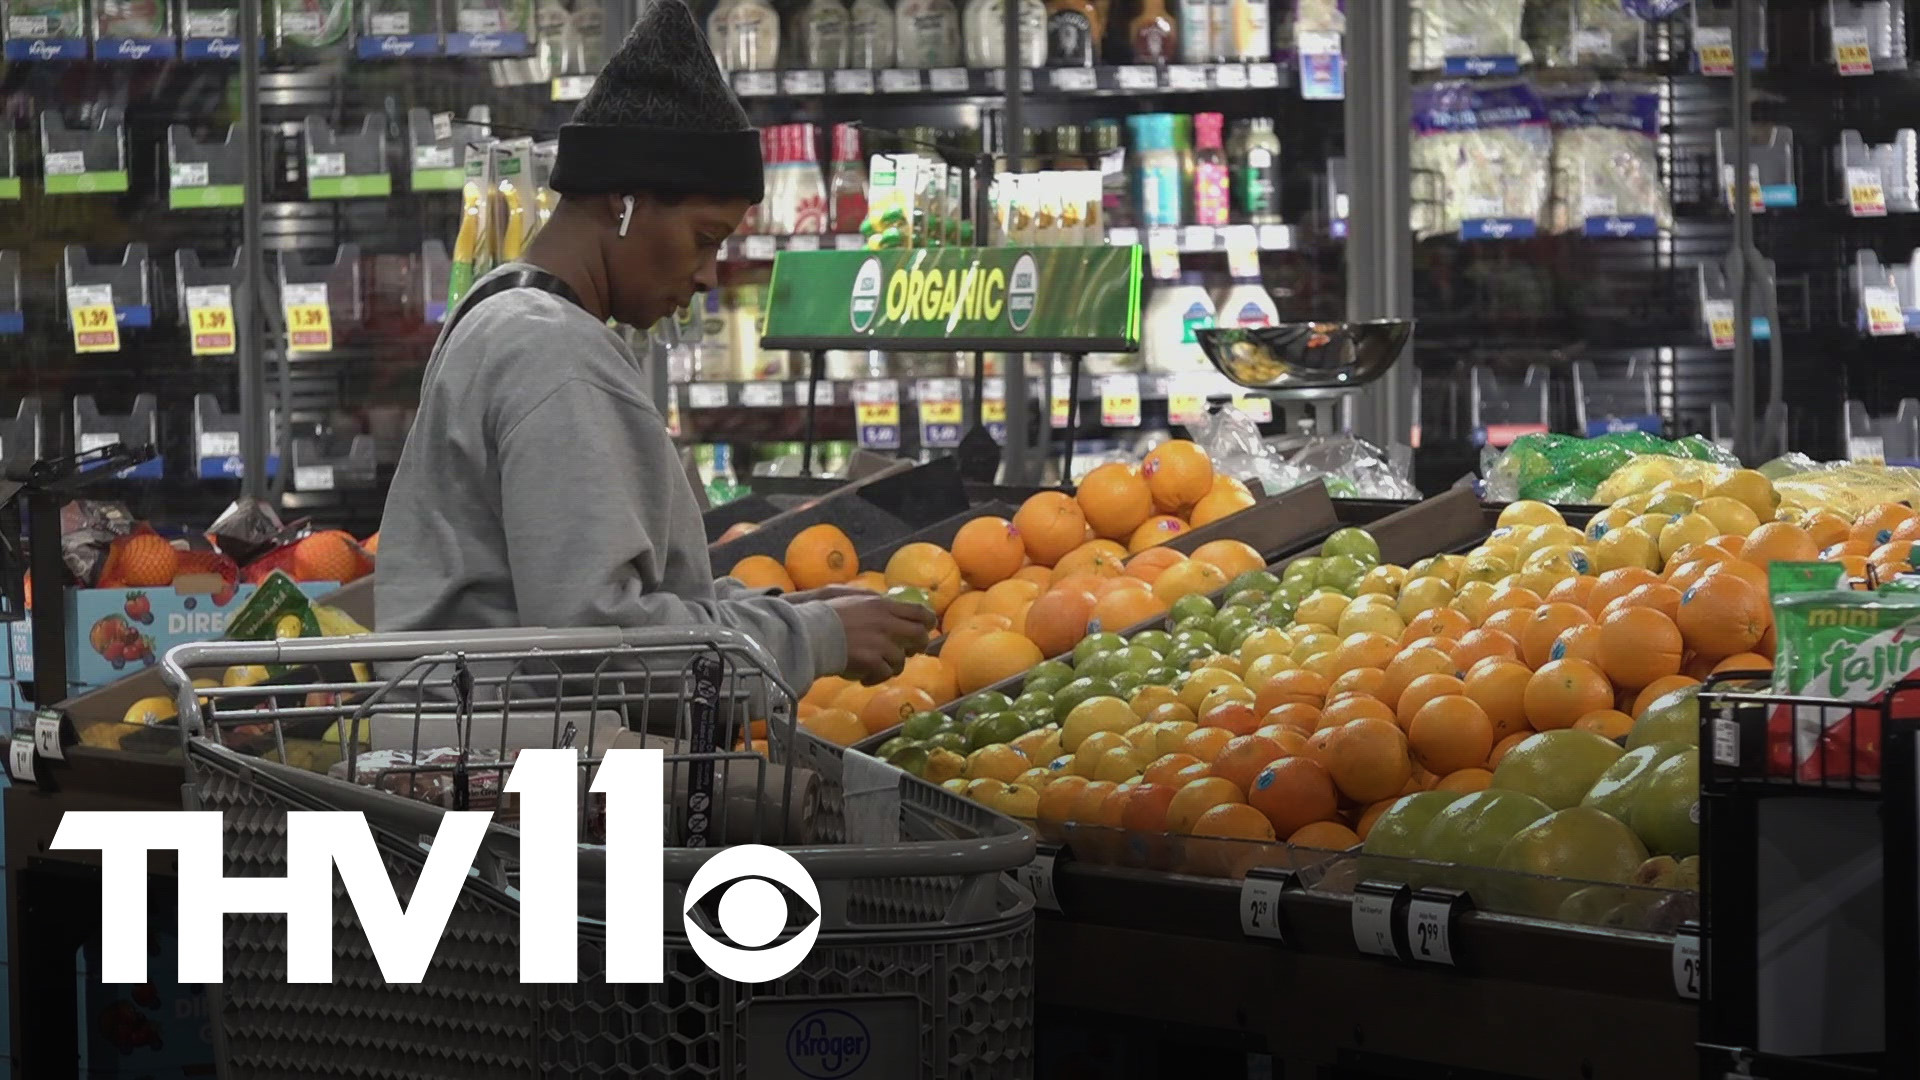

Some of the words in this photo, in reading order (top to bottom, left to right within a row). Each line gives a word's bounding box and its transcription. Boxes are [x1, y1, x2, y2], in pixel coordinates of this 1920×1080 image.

[886, 268, 1006, 322] ORGANIC
[78, 310, 109, 328] 1.39
[198, 312, 227, 329] 1.39
[293, 309, 323, 326] 1.39
[1807, 608, 1879, 627] mini
[795, 1018, 865, 1072] Kroger
